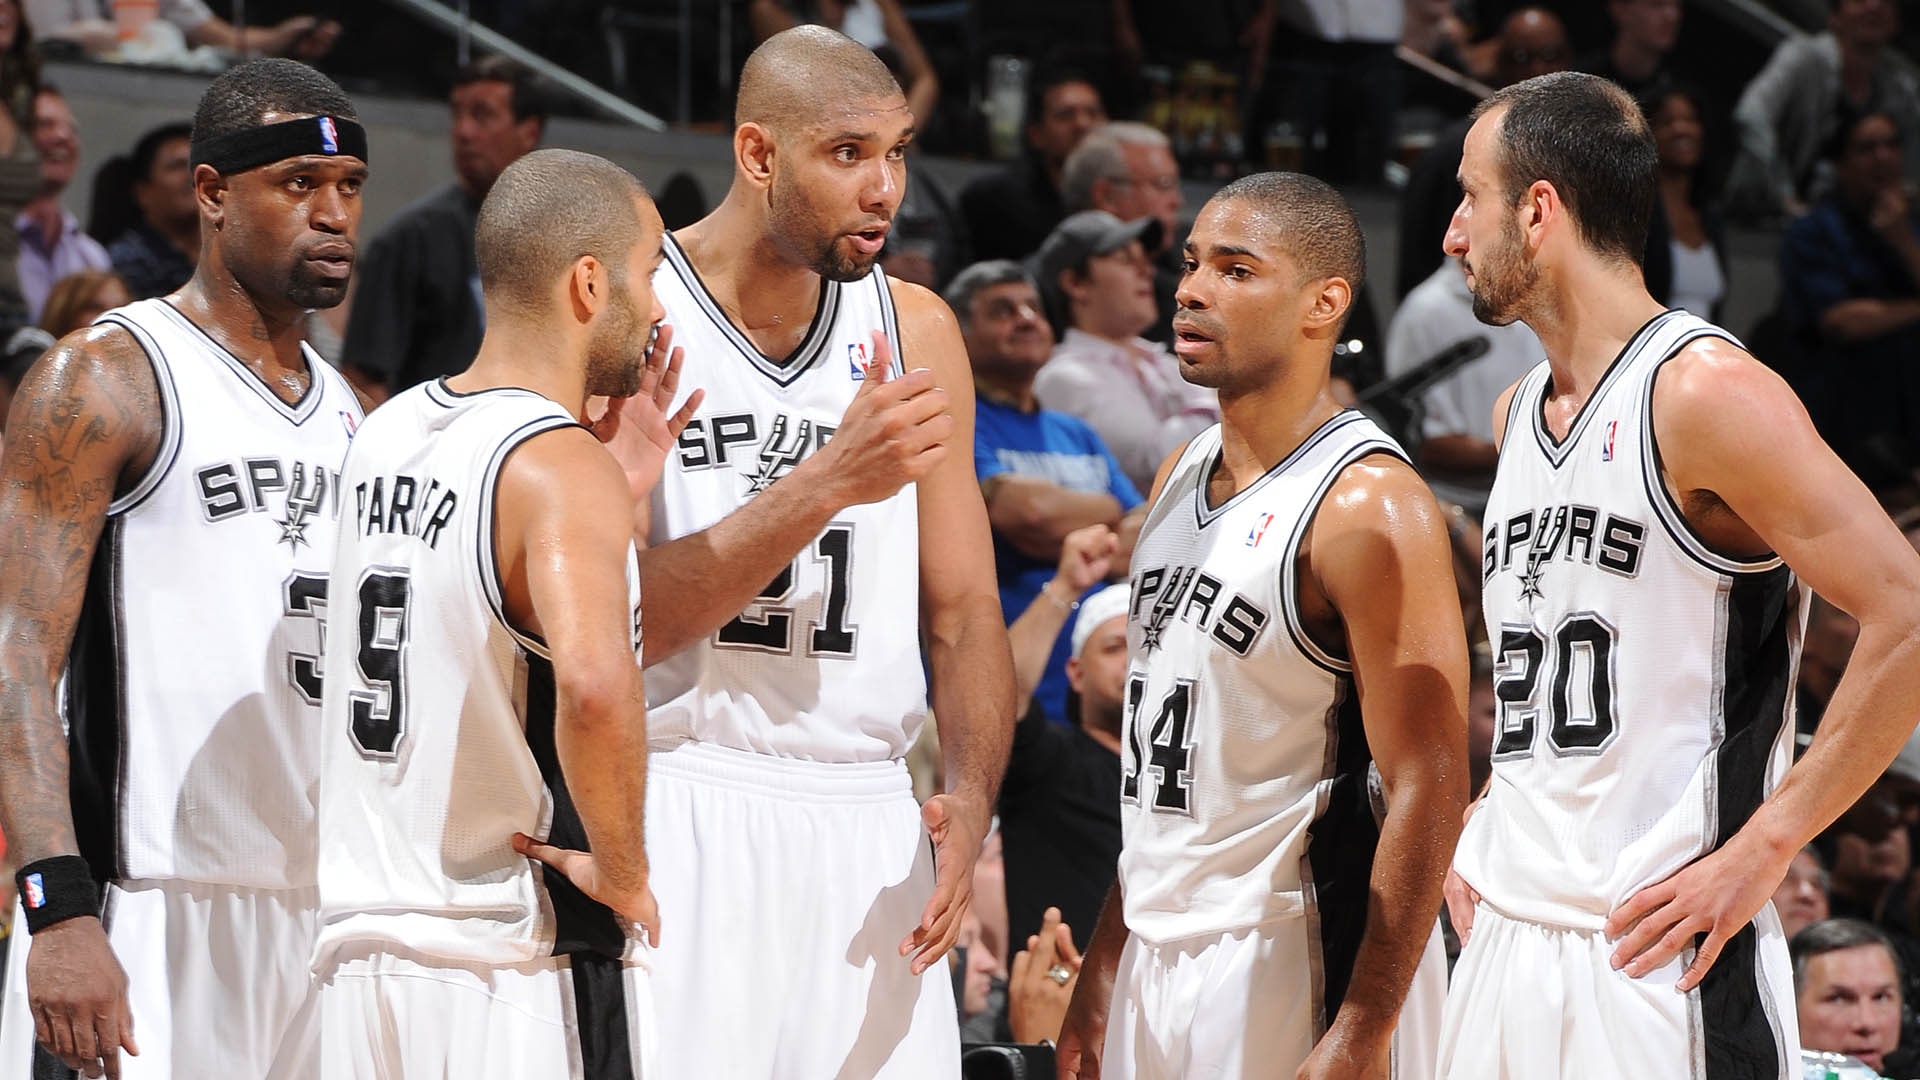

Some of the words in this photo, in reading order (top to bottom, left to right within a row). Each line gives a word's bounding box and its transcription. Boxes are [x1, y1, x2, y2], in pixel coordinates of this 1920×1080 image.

[674, 409, 839, 497] SPU
[194, 456, 341, 557] SPU
[355, 475, 458, 551] PARER
[1129, 564, 1271, 658] PURS
[1482, 505, 1649, 614] SPURS
[347, 565, 412, 762] 9
[1491, 611, 1620, 763] 20
[1121, 671, 1200, 815] 14
